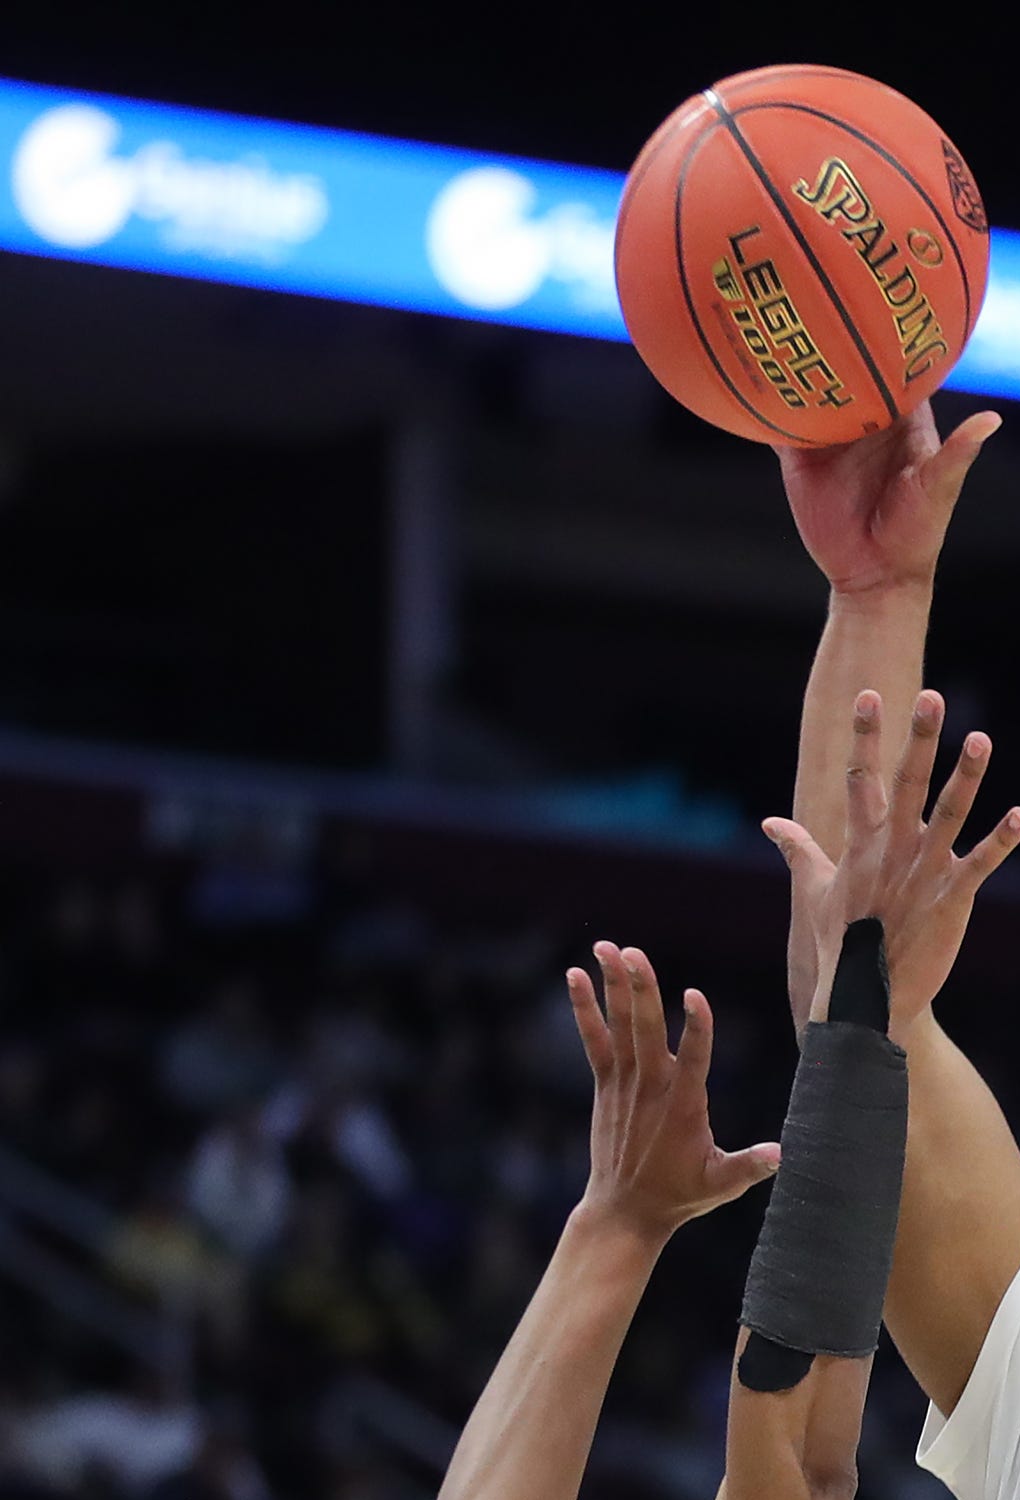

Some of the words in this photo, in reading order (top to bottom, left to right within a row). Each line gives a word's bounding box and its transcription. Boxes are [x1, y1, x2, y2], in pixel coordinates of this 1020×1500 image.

[727, 225, 856, 411] LEGACY
[730, 303, 809, 410] 1000
[791, 156, 949, 386] SPALDING
